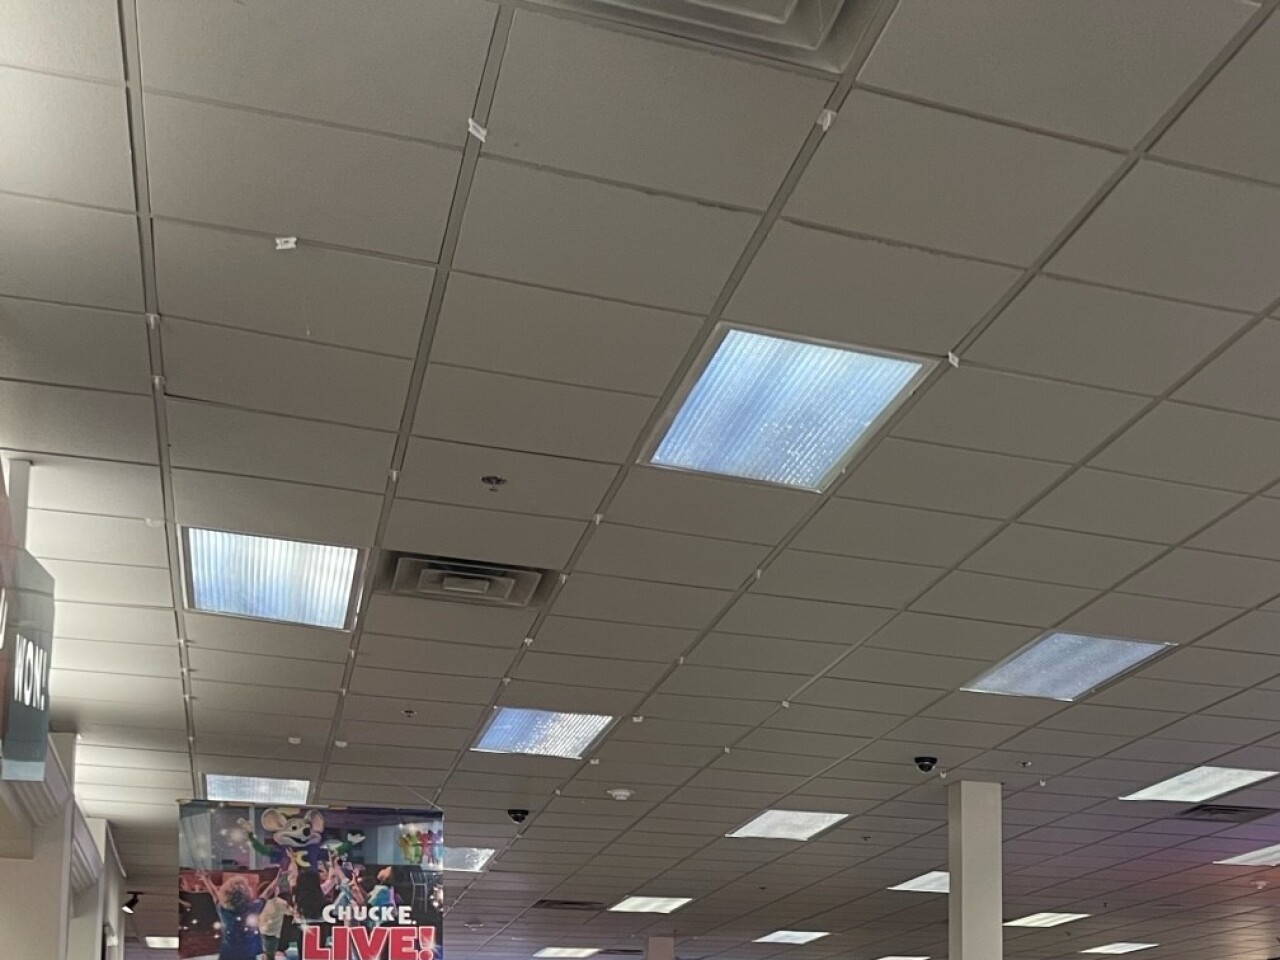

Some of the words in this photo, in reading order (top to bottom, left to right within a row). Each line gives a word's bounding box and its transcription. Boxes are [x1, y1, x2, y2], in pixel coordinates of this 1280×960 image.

[14, 633, 47, 711] WON!
[322, 904, 395, 924] CHUCK
[398, 905, 417, 925] E.
